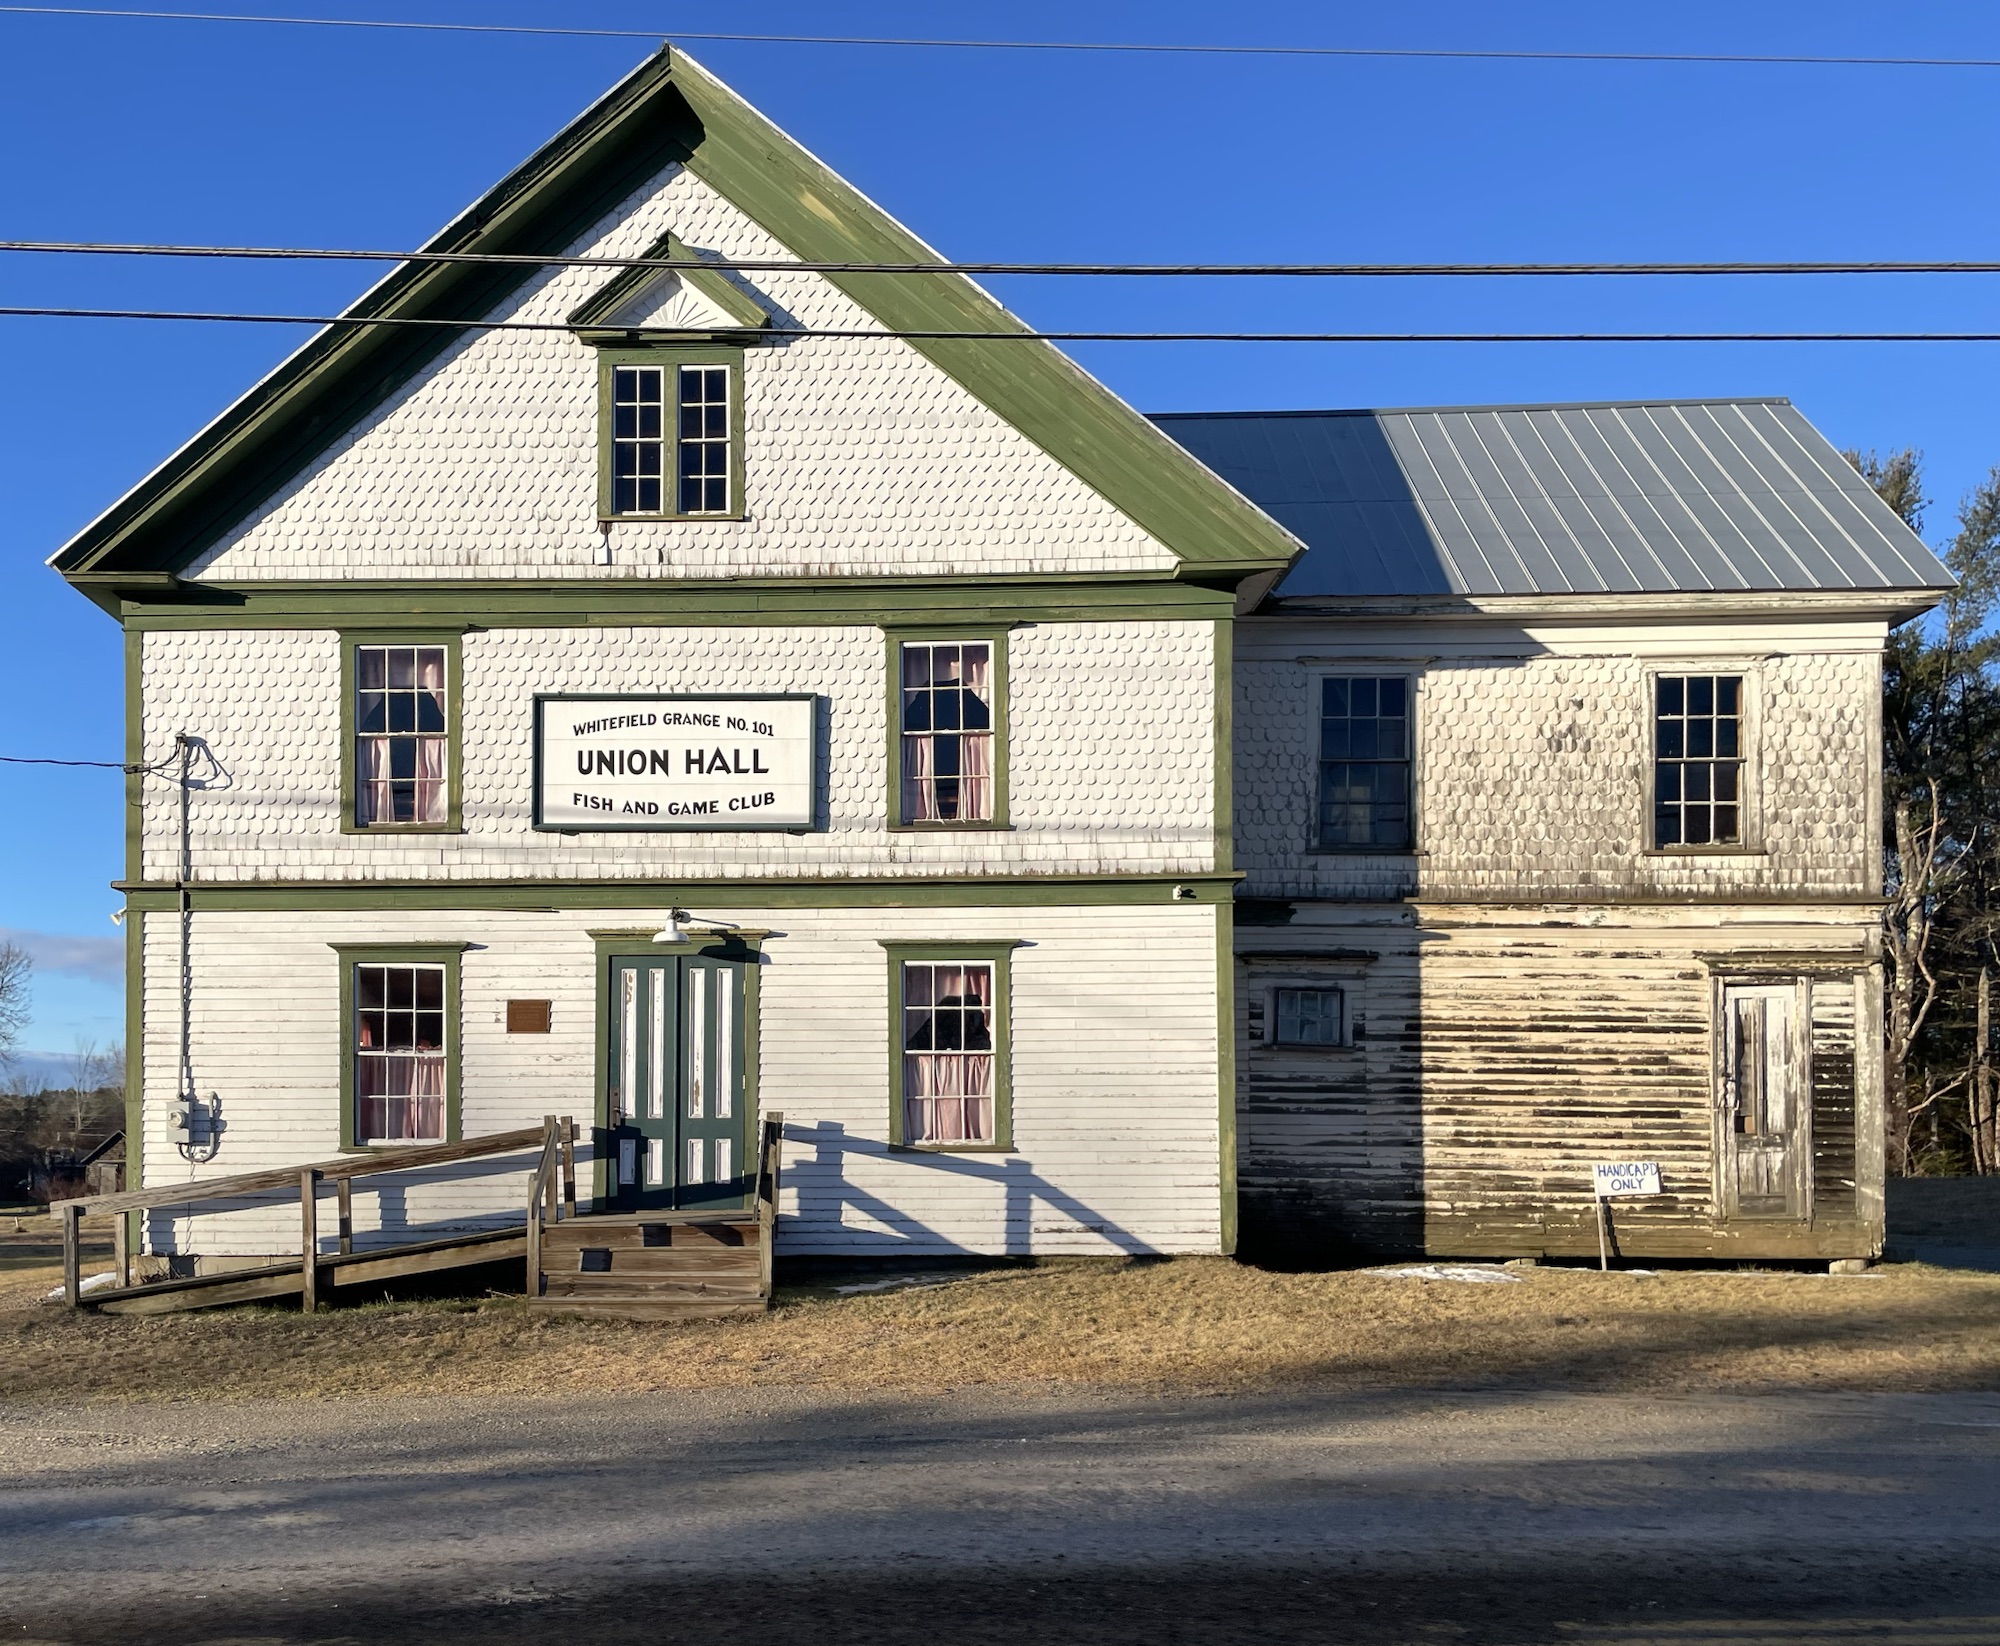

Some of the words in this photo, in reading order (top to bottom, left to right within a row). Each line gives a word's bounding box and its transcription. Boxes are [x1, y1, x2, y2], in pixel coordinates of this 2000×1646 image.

[573, 713, 657, 737] WHITEFIELD
[663, 712, 721, 728] GRANGE
[727, 716, 749, 732] NO.
[752, 721, 775, 737] 101
[577, 749, 669, 777] UNION
[685, 746, 770, 775] HALL
[573, 792, 613, 812] FISH
[622, 800, 659, 816] AND
[667, 800, 720, 816] GAME
[728, 791, 775, 812] CLUB
[1611, 1178, 1644, 1191] ONLY
